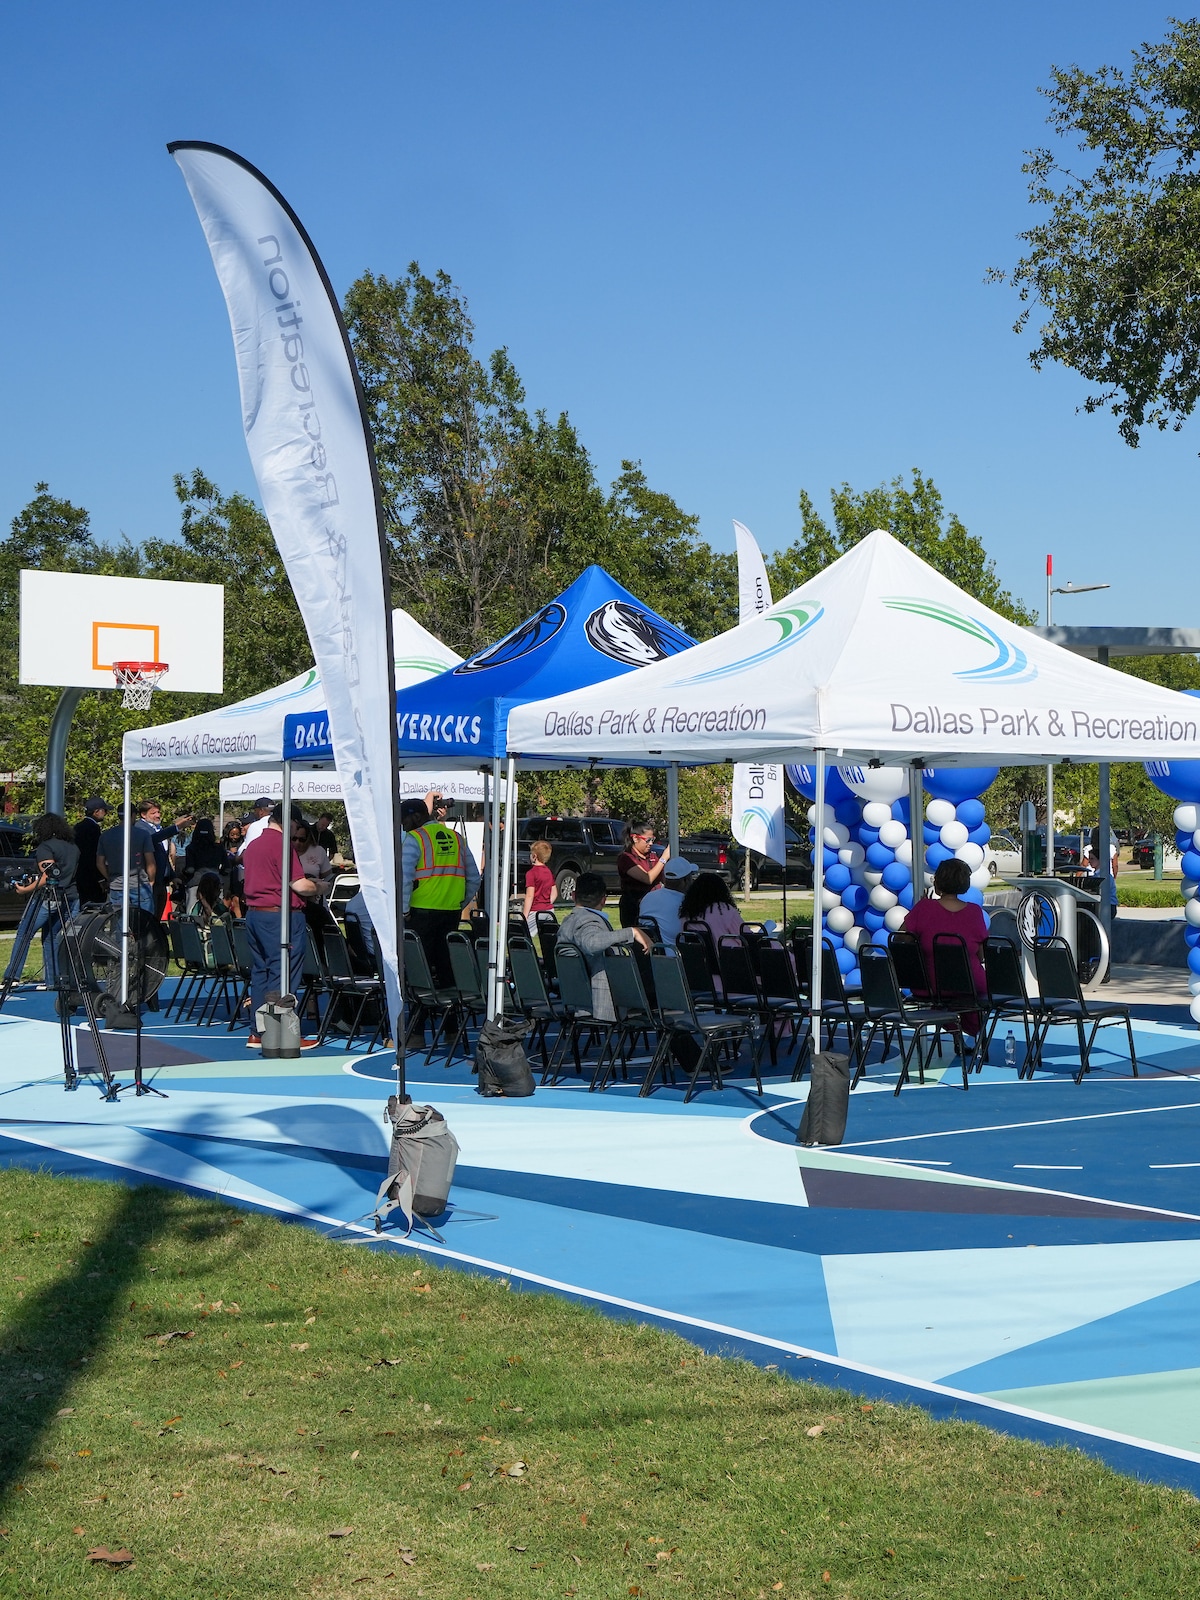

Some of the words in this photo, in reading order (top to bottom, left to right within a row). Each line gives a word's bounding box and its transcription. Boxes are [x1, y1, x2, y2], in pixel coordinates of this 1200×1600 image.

[396, 713, 482, 745] VERICKS
[544, 711, 594, 736] Dallas
[598, 708, 640, 735] Park
[642, 707, 657, 734] &
[661, 703, 767, 733] Recreation
[890, 703, 974, 734] Dallas
[979, 707, 1041, 736] Park
[1048, 709, 1066, 737] &
[1071, 710, 1197, 741] Recreation
[141, 738, 167, 758] Dallas
[168, 736, 190, 756] Park
[192, 734, 200, 755] &
[201, 731, 257, 754] Recreation
[241, 783, 270, 794] Dallas
[272, 782, 295, 793] Pak
[297, 781, 305, 793] &
[307, 782, 342, 793] Recrea
[403, 782, 429, 793] Dallas
[430, 782, 449, 793] Park
[450, 782, 457, 793] &
[749, 762, 765, 799] Dall
